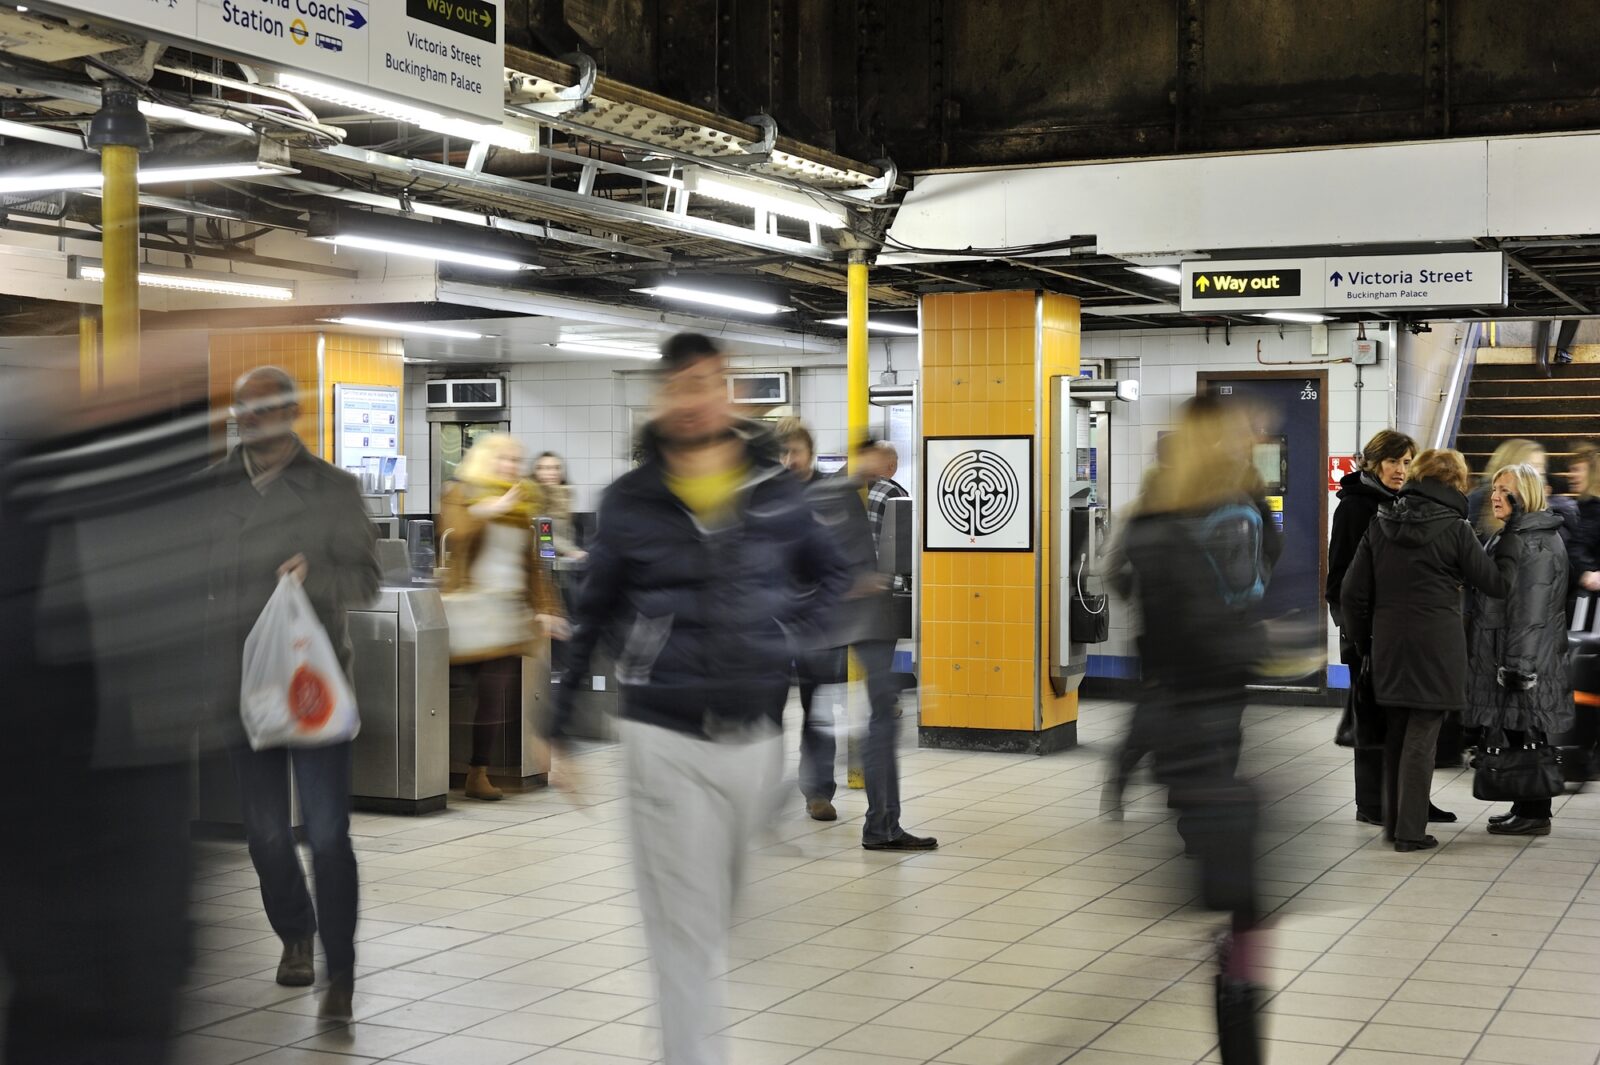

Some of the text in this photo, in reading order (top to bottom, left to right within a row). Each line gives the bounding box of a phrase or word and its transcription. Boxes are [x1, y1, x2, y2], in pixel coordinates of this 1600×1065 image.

[223, 0, 283, 37] Station
[296, 0, 345, 25] Coach
[426, 0, 479, 25] Way out
[407, 31, 482, 67] Victoria Street
[386, 53, 482, 93] Buckingham Palace
[1212, 275, 1280, 293] Way out
[1348, 269, 1473, 285] Victoria Street
[1346, 290, 1428, 300] Buckingham Palace
[1305, 380, 1312, 389] 2
[1300, 391, 1318, 400] 239
